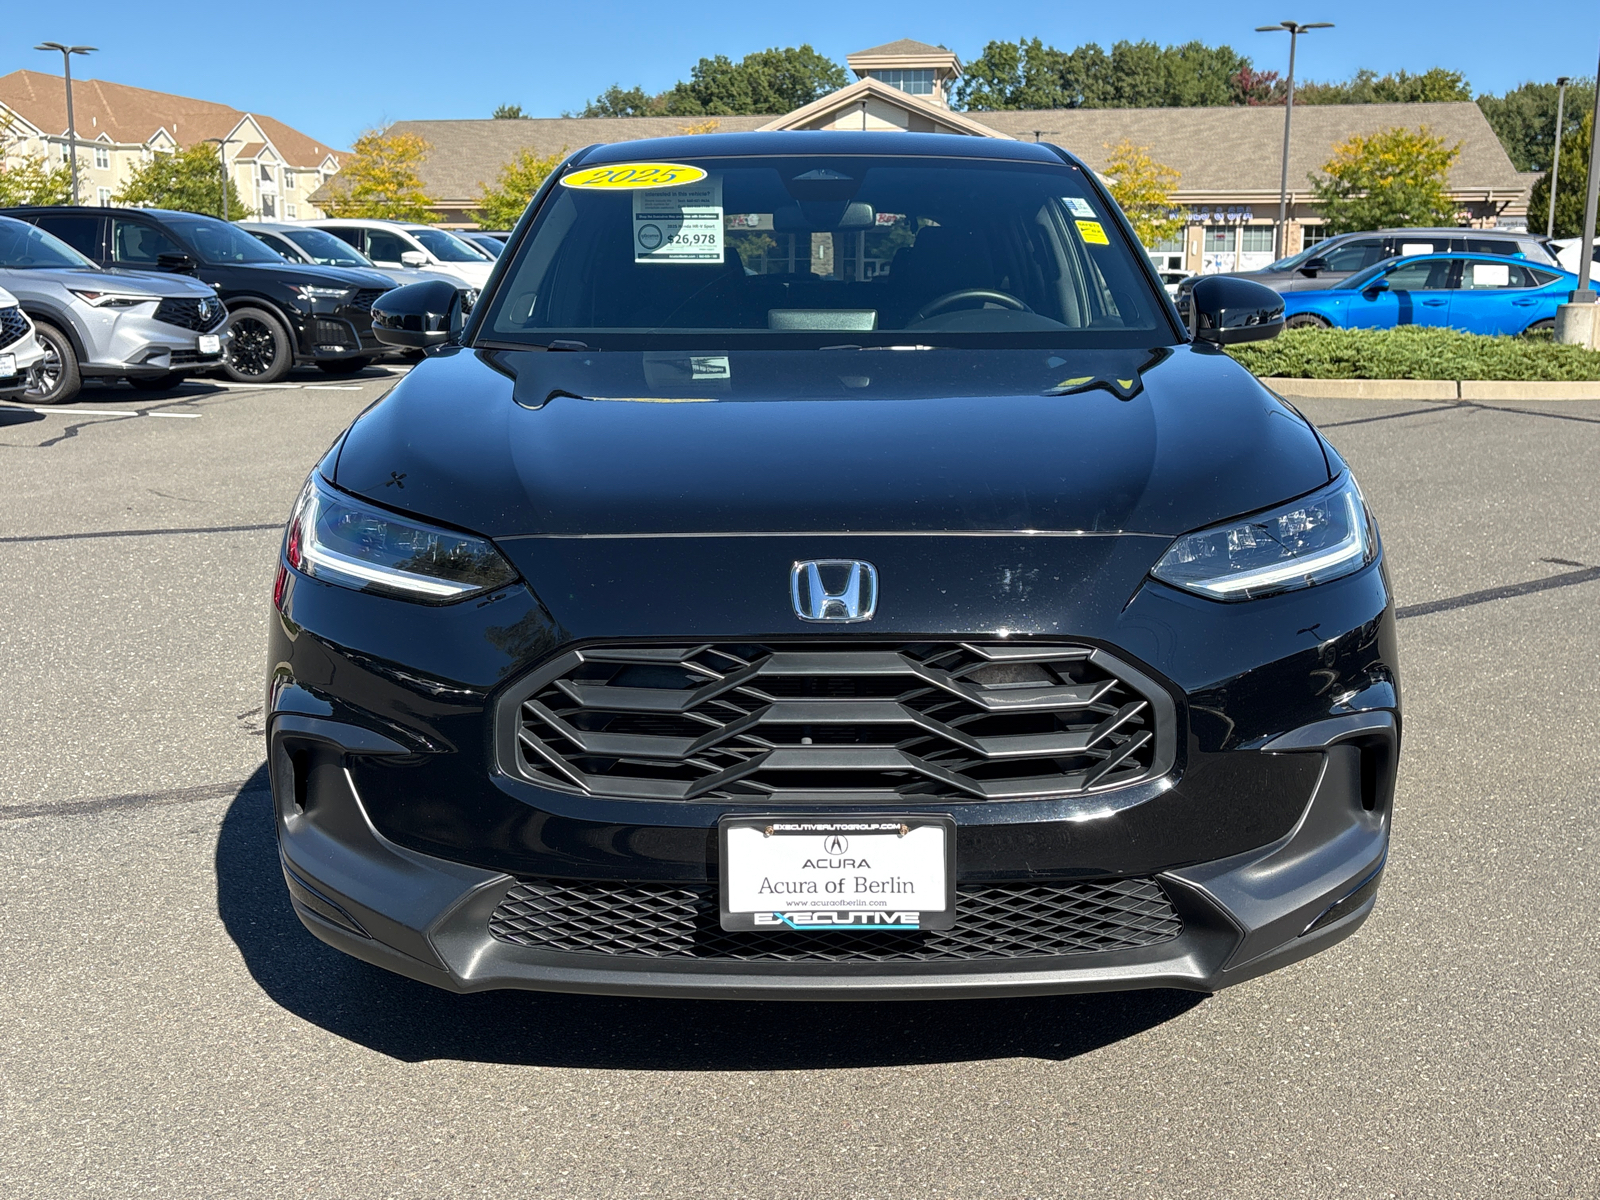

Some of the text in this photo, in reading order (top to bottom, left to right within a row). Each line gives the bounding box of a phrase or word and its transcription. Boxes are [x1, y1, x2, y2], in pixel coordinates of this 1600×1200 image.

[582, 168, 686, 185] 2025
[667, 233, 716, 246] $26,978
[802, 858, 871, 869] ACURA
[758, 876, 916, 895] Acura of Berlin
[785, 899, 888, 907] www.acuraofberlin.com
[754, 911, 920, 925] EXECUTIVE
